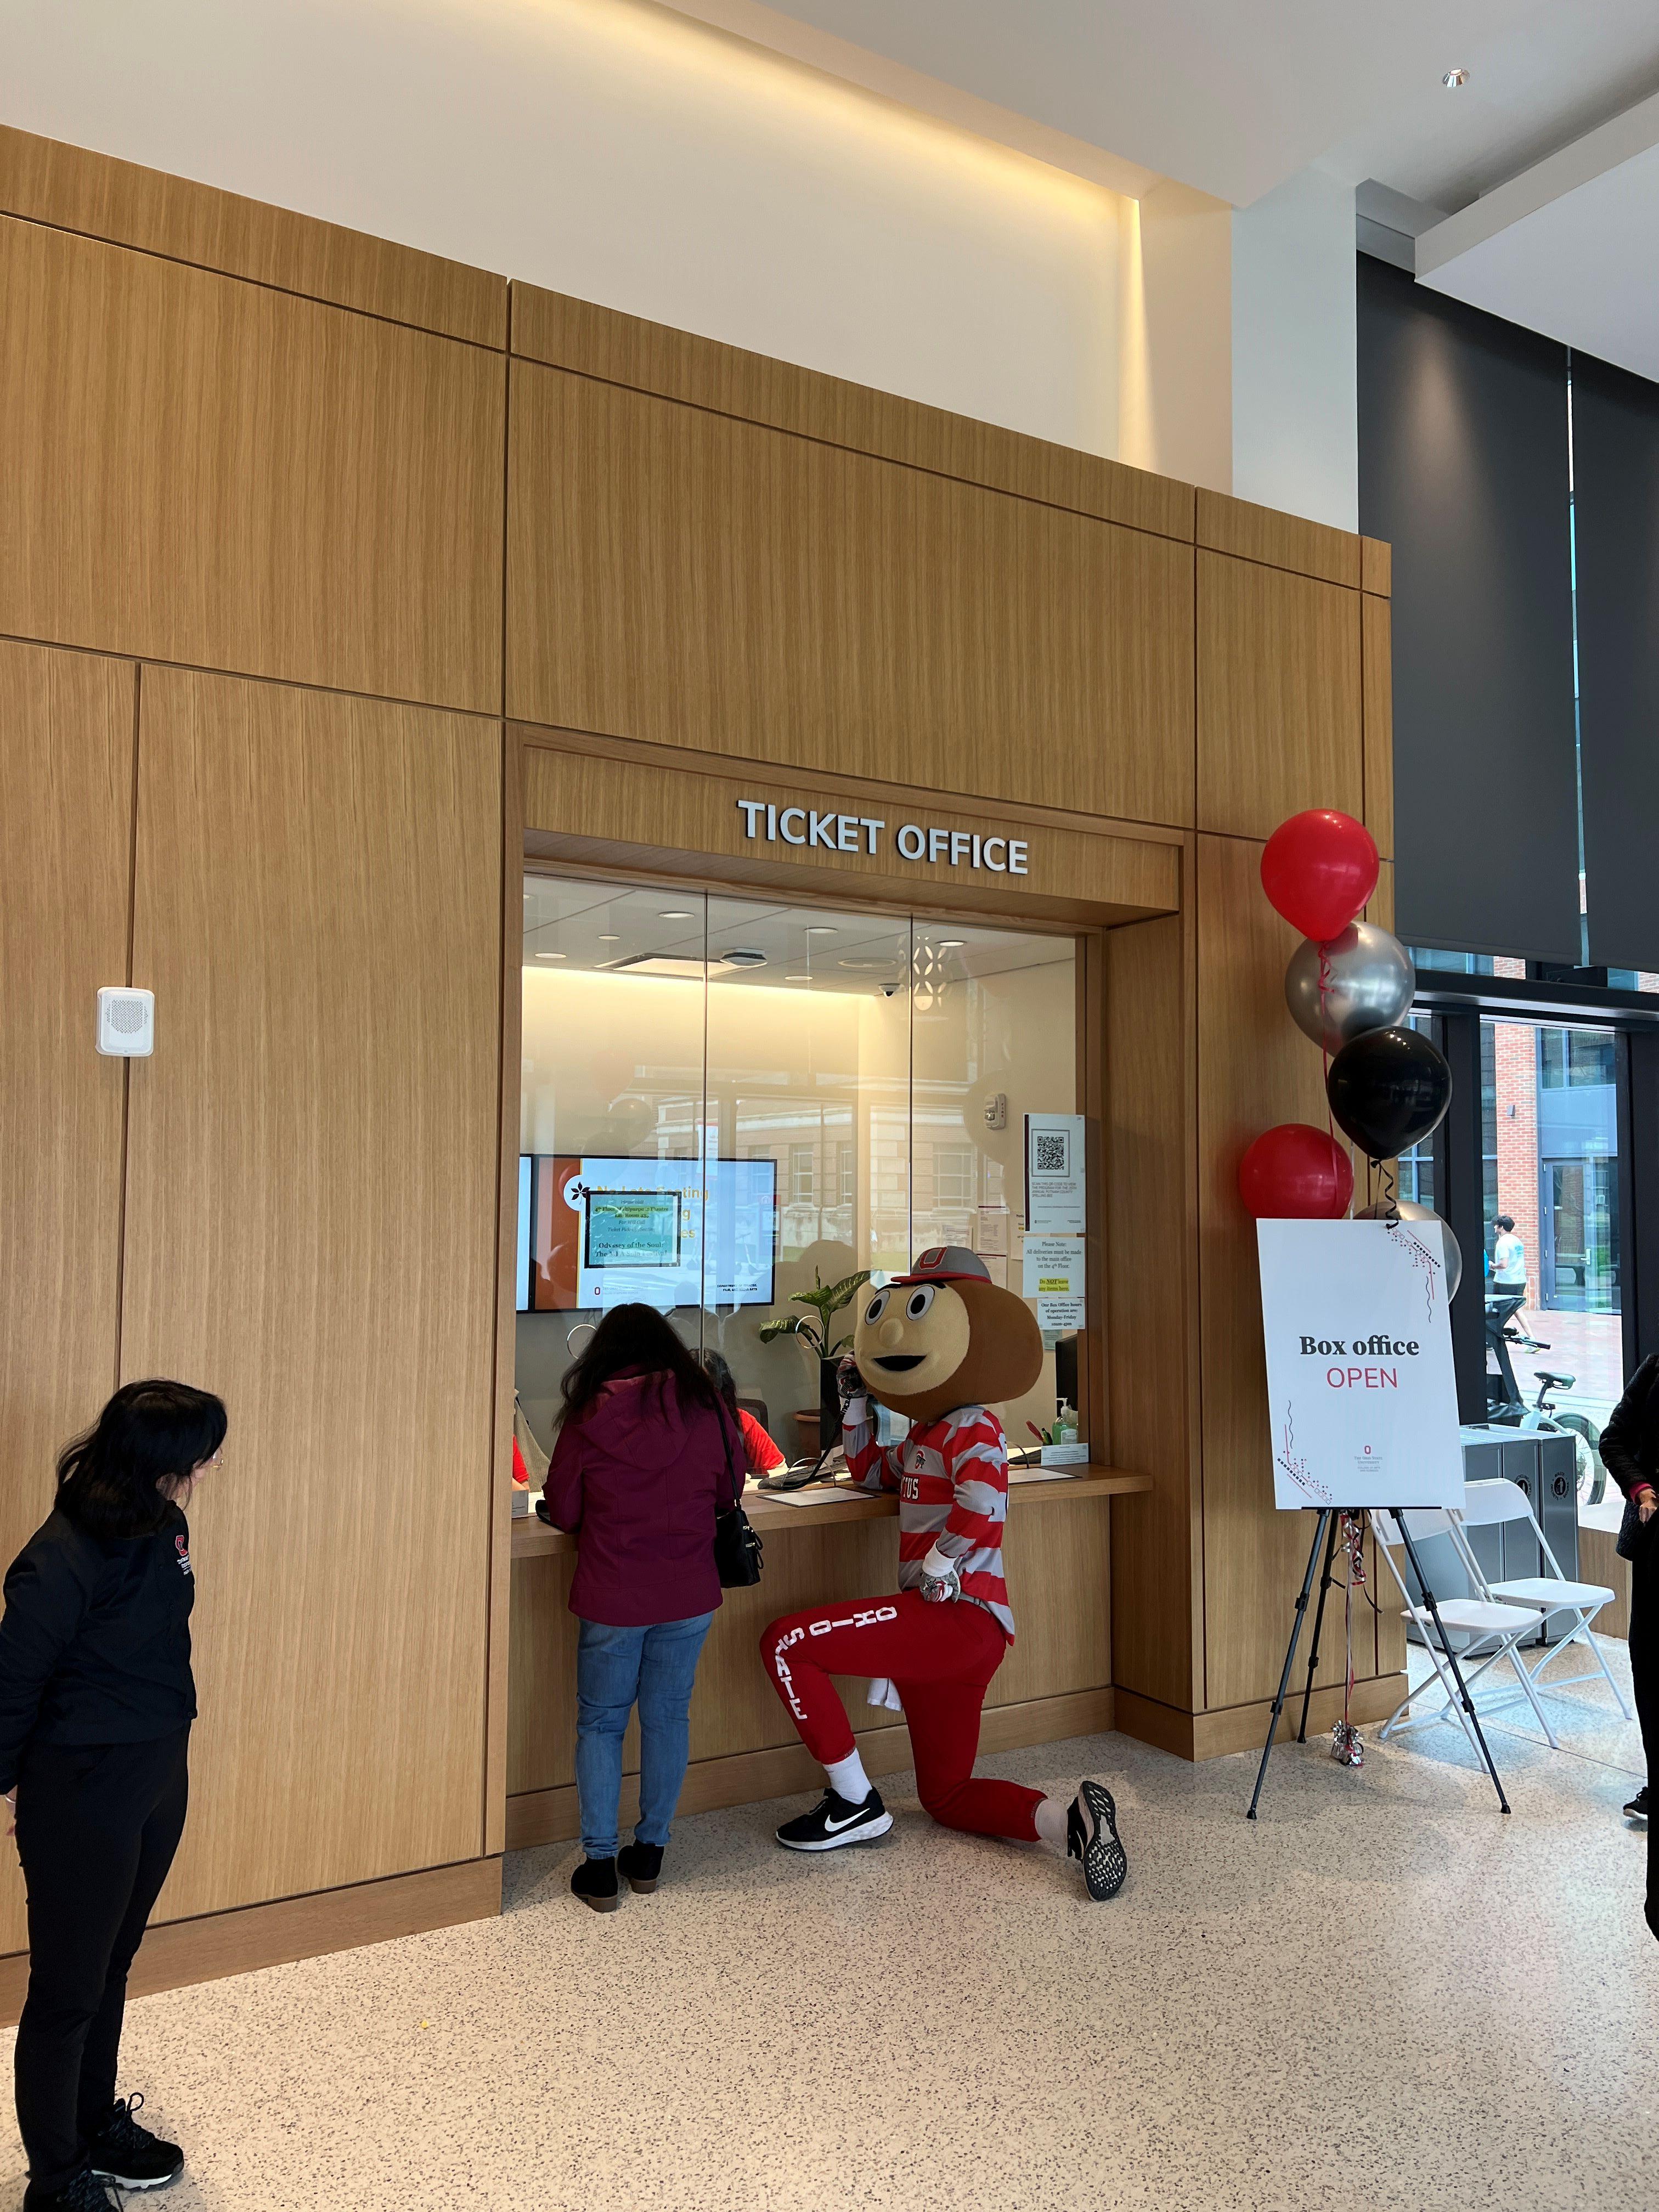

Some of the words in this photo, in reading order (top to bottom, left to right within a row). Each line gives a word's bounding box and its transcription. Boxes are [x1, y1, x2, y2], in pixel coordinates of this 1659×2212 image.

[737, 799, 885, 854] TICKET
[897, 825, 1029, 874] OFFICE
[1299, 1336, 1347, 1355] Box
[1353, 1335, 1419, 1356] office
[1327, 1368, 1397, 1388] OPEN
[809, 1606, 898, 1637] OHIO
[775, 1627, 808, 1719] STATE
